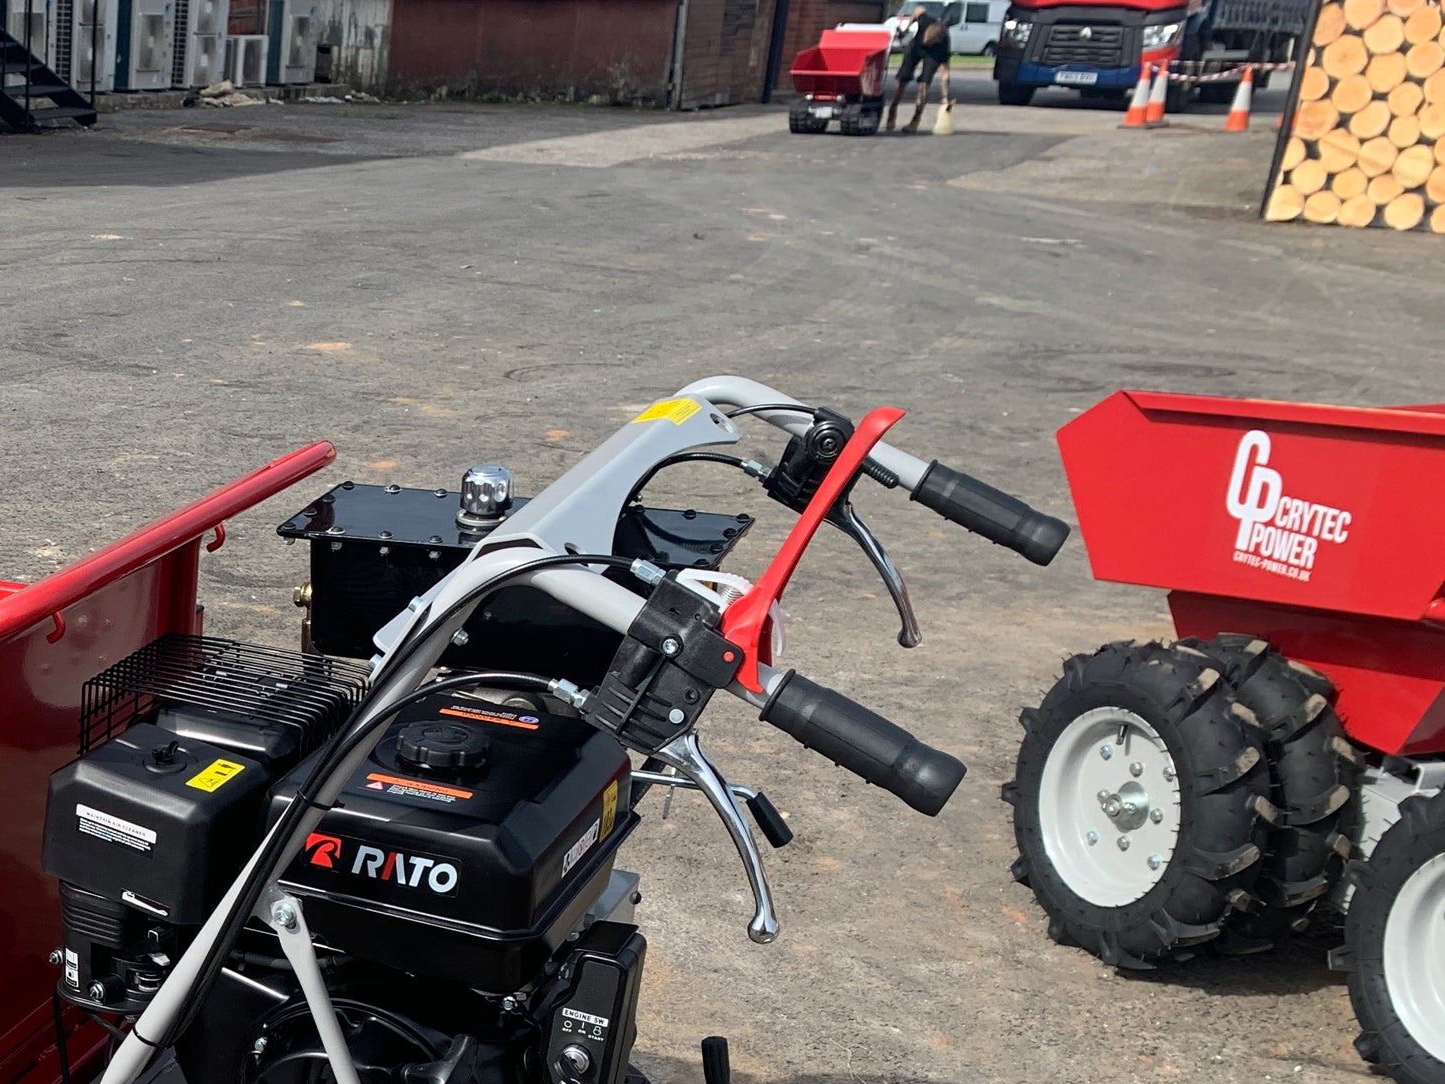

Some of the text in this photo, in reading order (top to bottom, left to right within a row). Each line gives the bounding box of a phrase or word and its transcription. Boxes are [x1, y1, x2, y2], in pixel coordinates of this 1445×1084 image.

[1275, 496, 1352, 544] CRYTEC
[1233, 550, 1312, 582] CRYTEC-POWER.CO.UK
[1249, 522, 1318, 569] POWER
[351, 844, 458, 894] RATO
[564, 1010, 591, 1021] ENGINE
